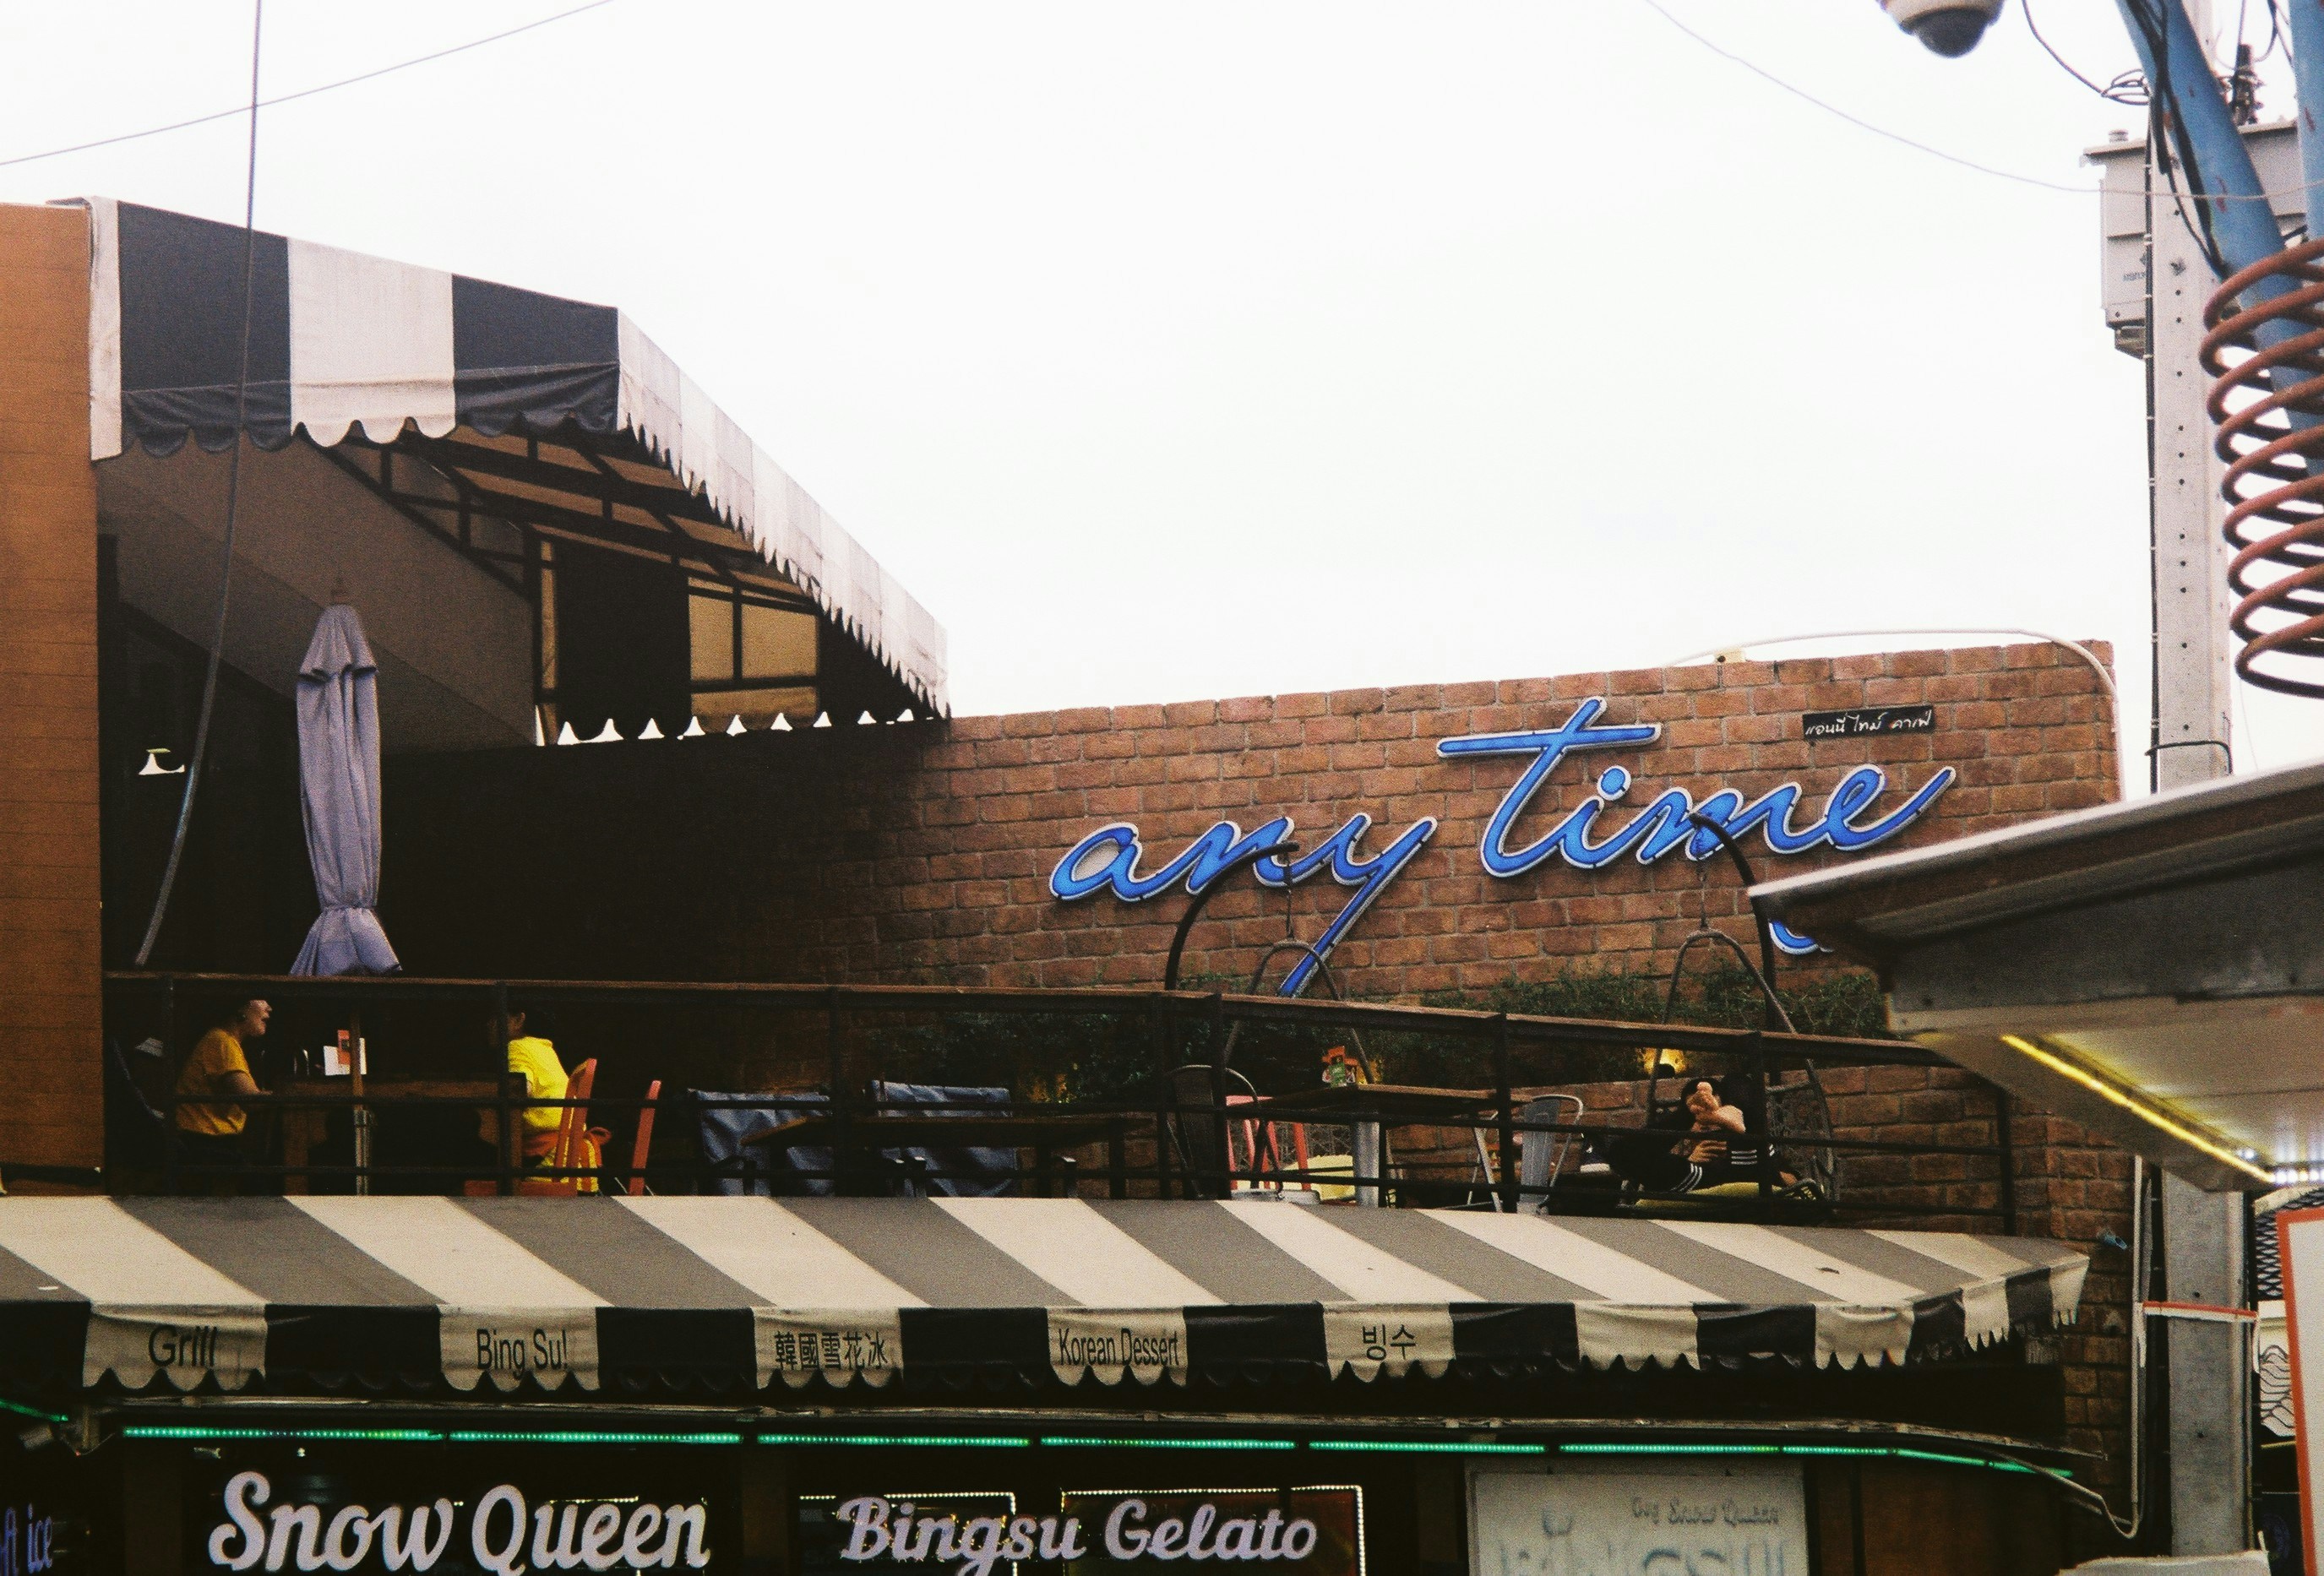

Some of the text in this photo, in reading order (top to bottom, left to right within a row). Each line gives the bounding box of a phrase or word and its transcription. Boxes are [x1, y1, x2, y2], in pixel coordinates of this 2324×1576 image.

[1049, 695, 1957, 998] any time
[149, 1324, 218, 1367] Grill
[476, 1328, 568, 1381] Bing Su!
[773, 1330, 888, 1372] 韓國雪花冰
[1059, 1327, 1179, 1367] Korean Dessert
[1362, 1323, 1416, 1361] 빙수
[208, 1470, 712, 1576] Snow Queen
[835, 1496, 1318, 1576] Bingsu Gelato
